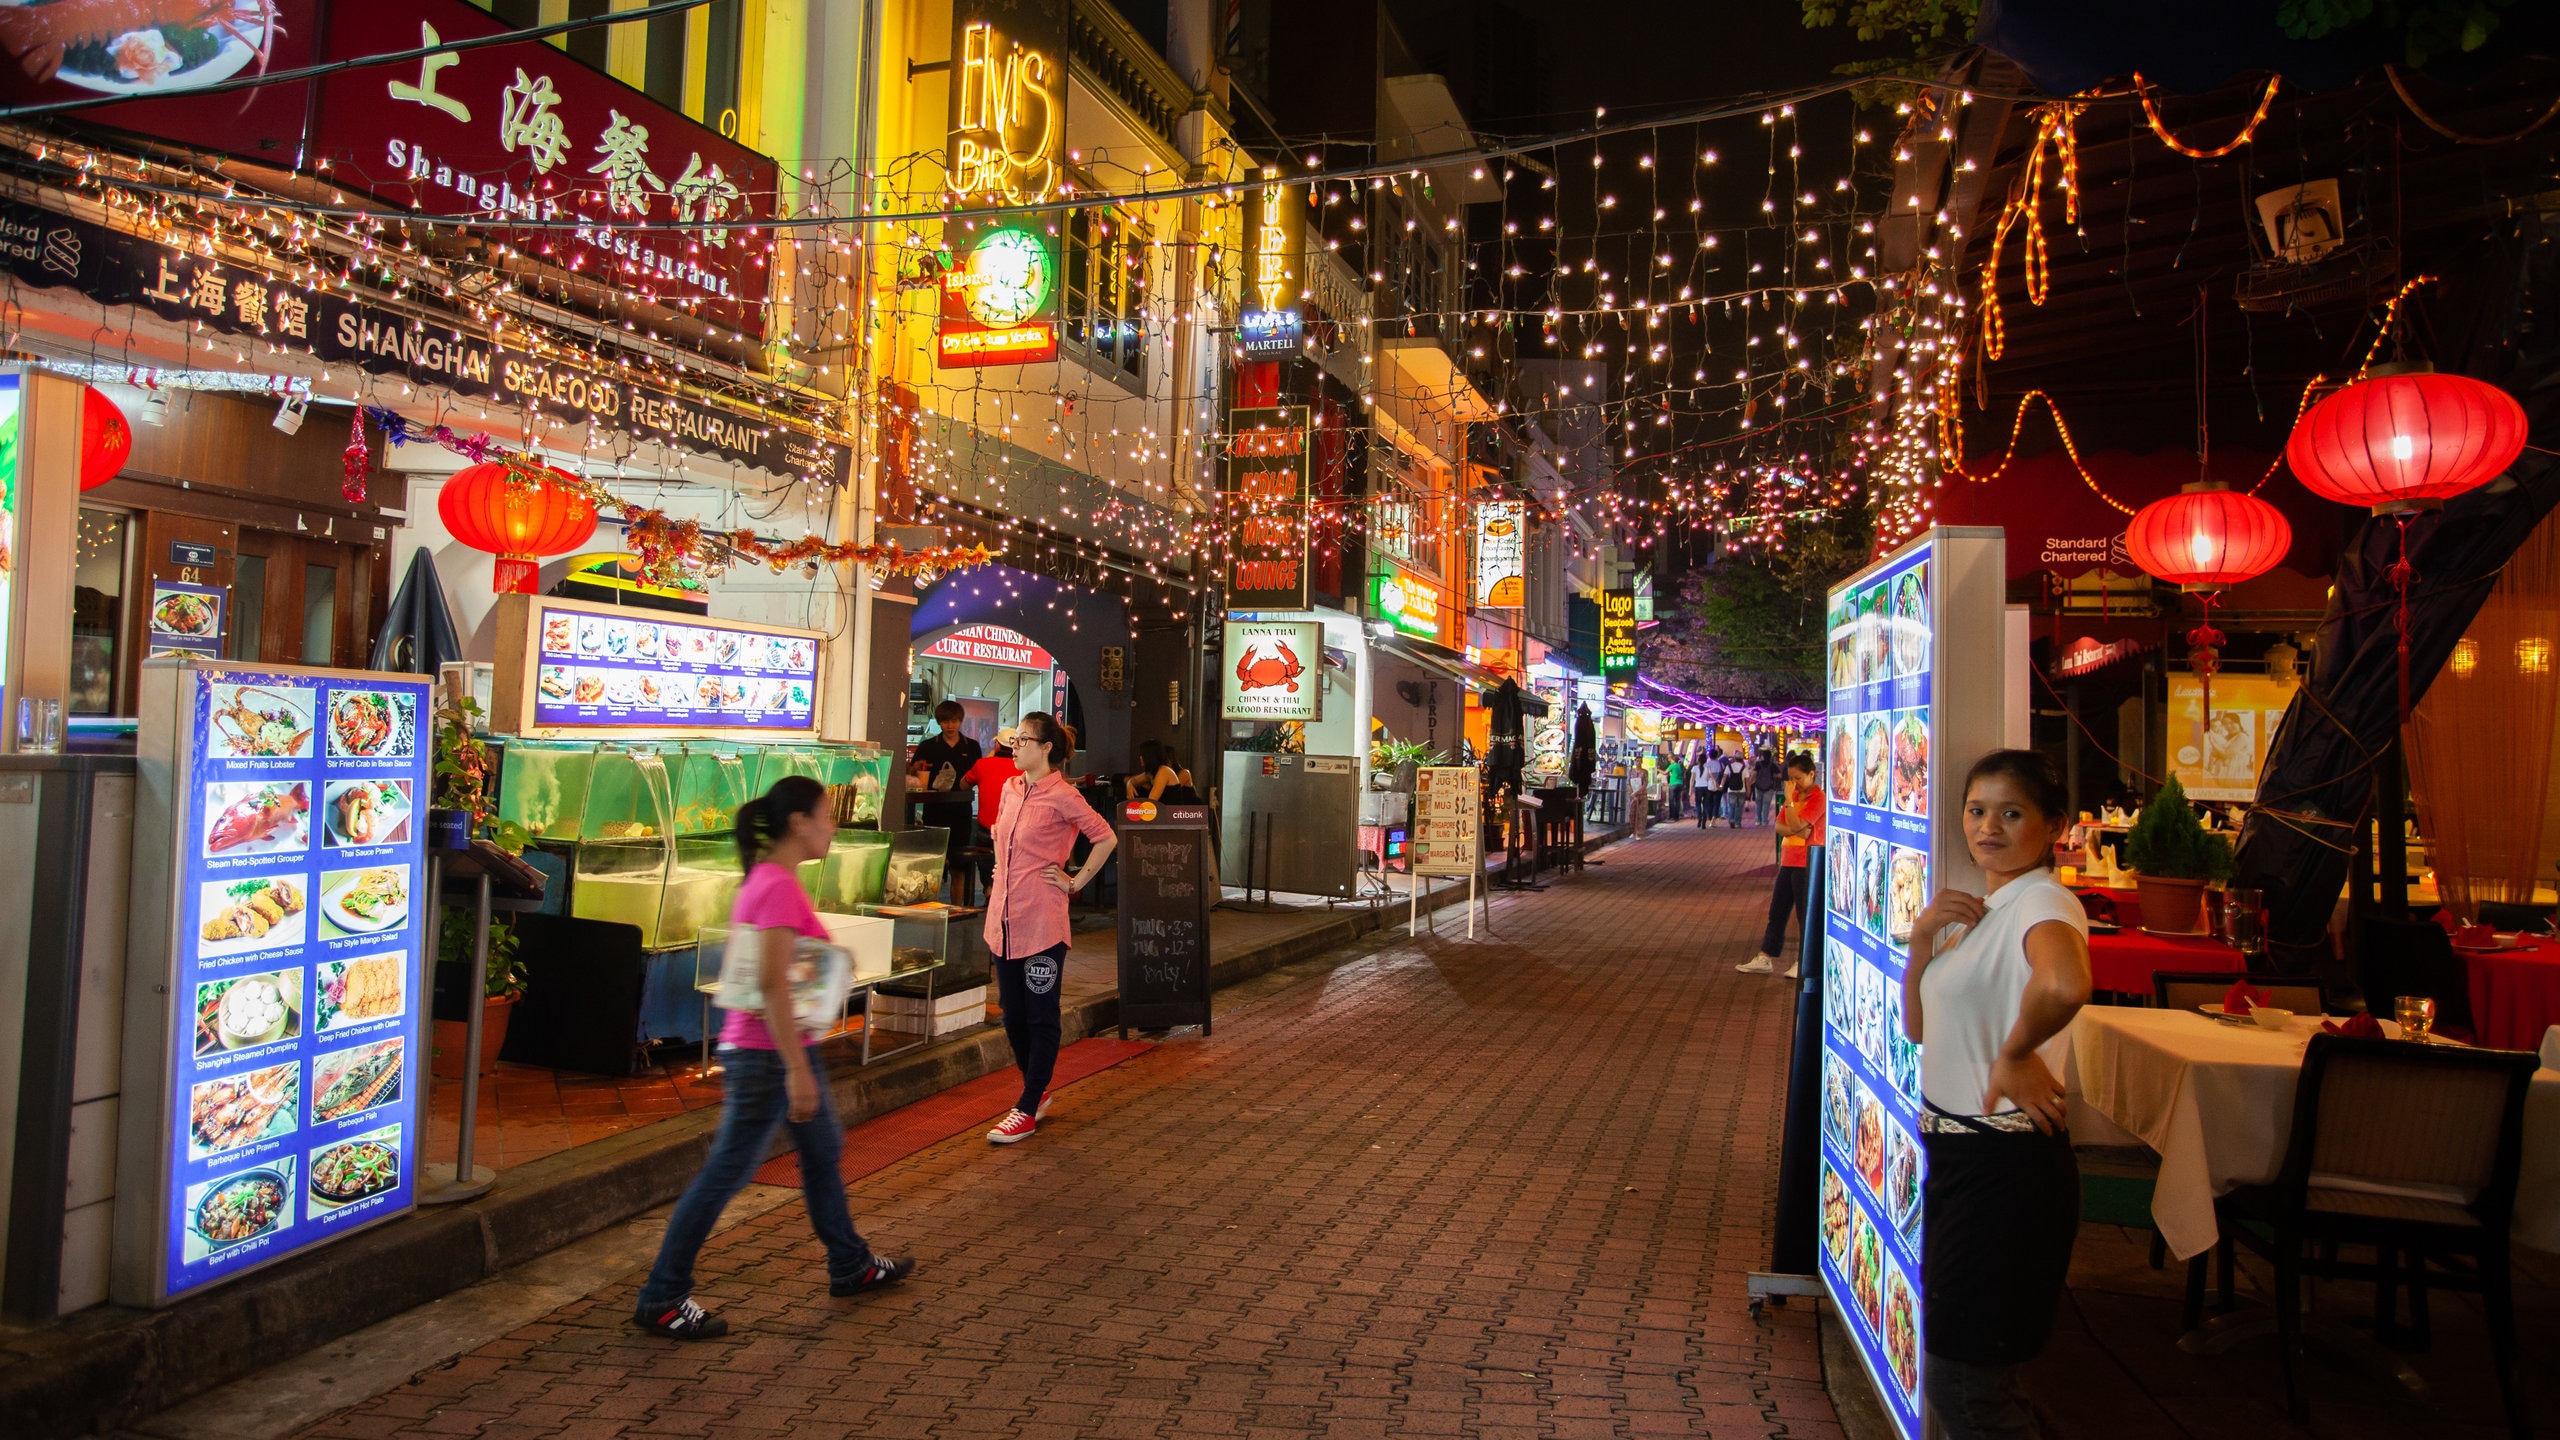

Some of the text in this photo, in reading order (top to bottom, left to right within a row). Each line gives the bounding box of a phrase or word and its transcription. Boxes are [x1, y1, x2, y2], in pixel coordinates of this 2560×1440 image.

[387, 138, 732, 298] Shanghai Restaurant
[143, 257, 309, 340] 上海餐馆
[942, 335, 961, 349] Dry
[337, 312, 763, 456] SHANGHAI SEAFOOD RESTAURANT
[1240, 471, 1298, 500] INDIAN
[1242, 515, 1294, 546] MUSIC
[2046, 537, 2107, 550] Standard
[2041, 551, 2107, 563] Chartered
[181, 566, 201, 582] 64
[1235, 560, 1297, 591] LOUNGE
[1605, 592, 1632, 617] Lago
[1604, 617, 1634, 628] Seafood
[984, 626, 1024, 645] CHINESE
[1242, 627, 1296, 636] LANNA THAI
[936, 640, 1032, 665] CURRY RESTAURANT
[1238, 695, 1300, 705] CHINESE & THAI
[1226, 705, 1312, 715] SEAFOOD RESTAURANT
[1427, 681, 1437, 751] PARDIS
[226, 760, 296, 769] Mixed Fruits Lobster
[327, 760, 412, 768] Stir Fried Crab in Bean Sauce
[1435, 777, 1451, 786] JUG
[1126, 807, 1158, 816] MasterCard
[1434, 801, 1452, 810] MUG
[1173, 810, 1203, 819] citibank
[440, 821, 463, 830] seated
[1431, 821, 1455, 829] SINGAPORE
[1436, 830, 1450, 838] SLING
[341, 847, 394, 858] Thai Sauce Prawn
[1429, 849, 1455, 858] MARGARITA
[207, 854, 305, 869] Steam Red-Spotted Grouper
[329, 932, 398, 950] Thai Style Mango Salad
[198, 960, 217, 970] Fried
[217, 955, 244, 967] Chicken
[259, 950, 284, 961] Cheese
[284, 946, 304, 957] Sause
[1030, 966, 1050, 975] NYPD
[318, 1033, 335, 1044] Deep
[335, 1029, 350, 1040] Fried
[350, 1025, 372, 1036] Chicken
[373, 1022, 384, 1031] with
[196, 1042, 298, 1071] Shanghai Steamed Dumpling
[337, 1111, 378, 1129] Barbeque Fish
[208, 1140, 280, 1167] Barbeque Live Prawns
[323, 1196, 385, 1224] Deer Meat in Hot Plate
[209, 1237, 270, 1266] Beef with Chilli Pot
